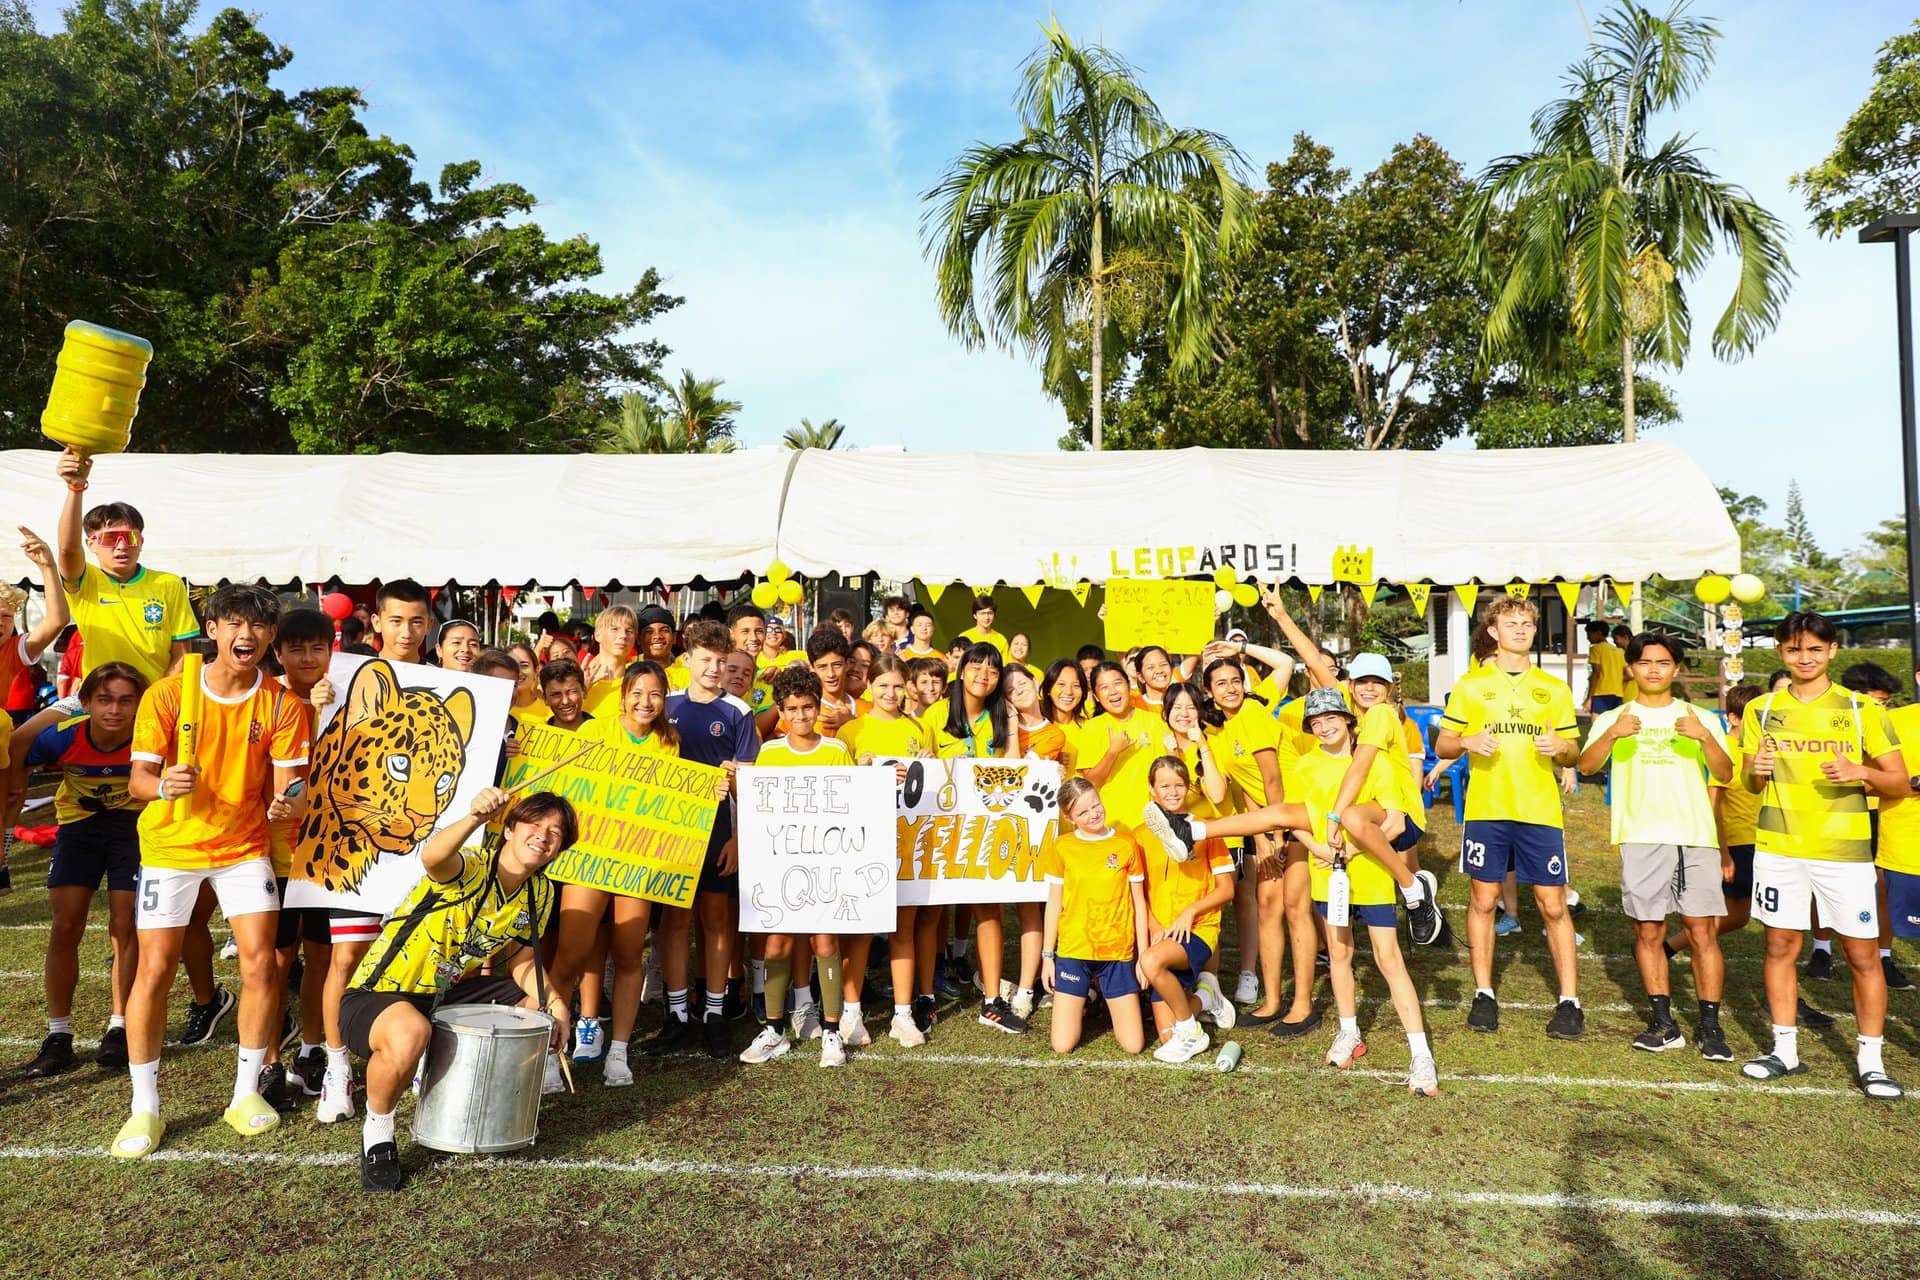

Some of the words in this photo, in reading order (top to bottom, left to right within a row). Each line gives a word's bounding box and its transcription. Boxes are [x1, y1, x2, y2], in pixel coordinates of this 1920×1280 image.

[1110, 543, 1297, 576] LEOPARDS!
[518, 723, 576, 763] YELLOW
[621, 753, 664, 787] HEAR
[662, 763, 688, 790] US
[679, 770, 723, 801] ROAR
[605, 783, 637, 811] WE
[635, 788, 677, 821] WILL
[670, 800, 717, 832] SCORE
[752, 775, 851, 814] THE
[766, 824, 866, 856] YELLOW
[897, 814, 1059, 882] YELLOW
[1465, 838, 1486, 868] 23
[143, 878, 161, 912] 5
[573, 853, 621, 887] RAISE
[612, 863, 648, 893] OUR
[645, 868, 694, 902] VOICE
[752, 862, 890, 929] SQUAD
[1754, 881, 1779, 913] 49
